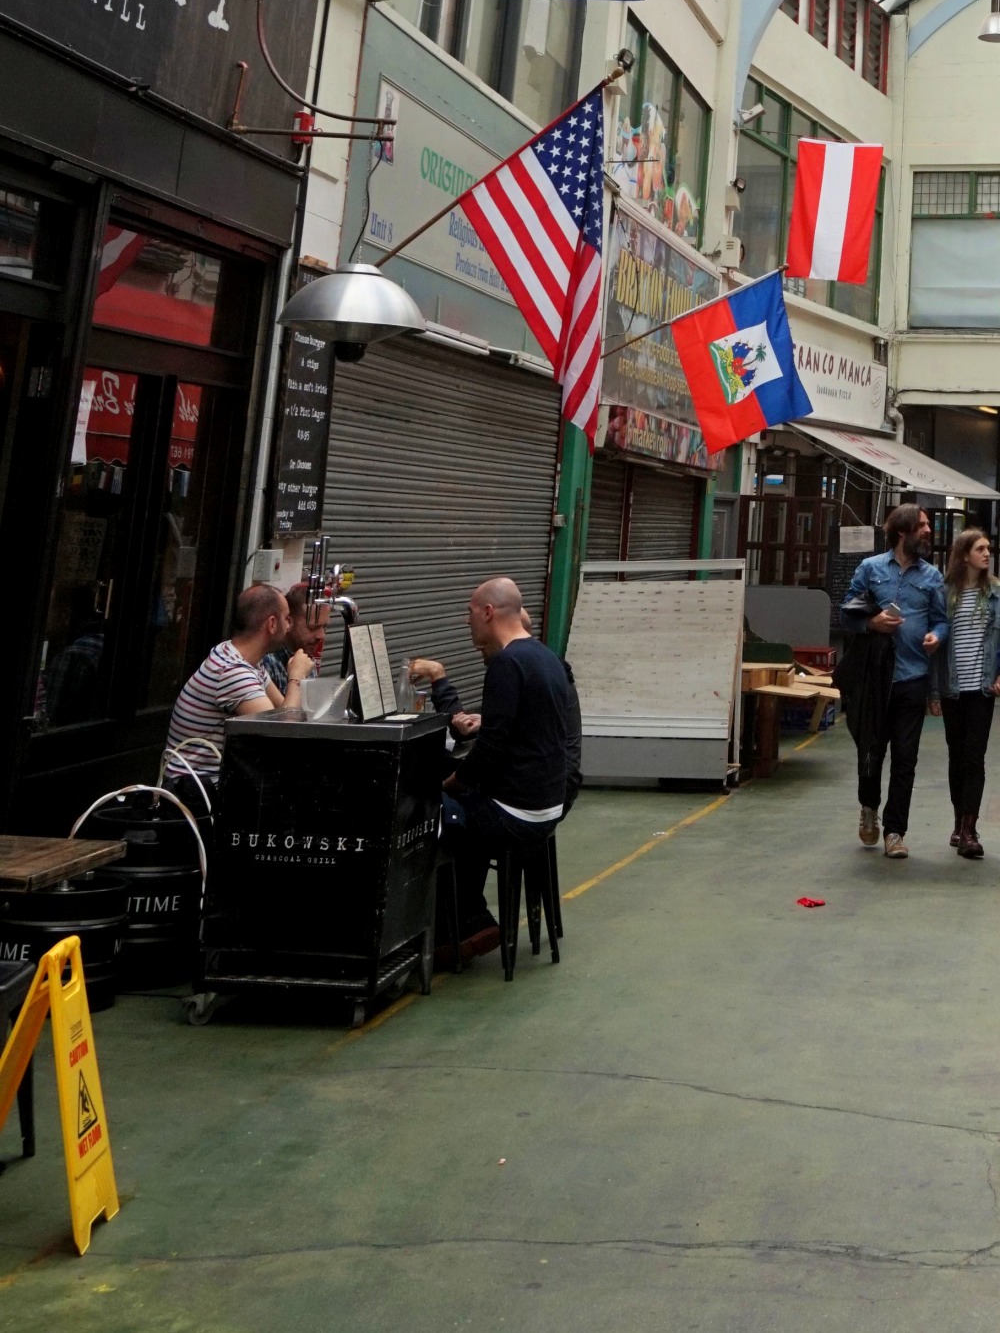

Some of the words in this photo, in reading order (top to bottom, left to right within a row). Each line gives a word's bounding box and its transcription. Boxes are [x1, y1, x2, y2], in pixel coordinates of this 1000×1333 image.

[370, 212, 388, 241] Unit
[387, 222, 394, 244] 8
[455, 251, 477, 280] Products
[616, 247, 664, 320] BRIXTON
[793, 343, 835, 376] RANCO
[837, 356, 872, 388] MANCA
[231, 831, 365, 852] BUKOWSKI
[254, 853, 301, 863] CHARCOAL
[306, 856, 337, 865] GRILL
[127, 895, 181, 913] TIME
[69, 1038, 89, 1068] CAUTION
